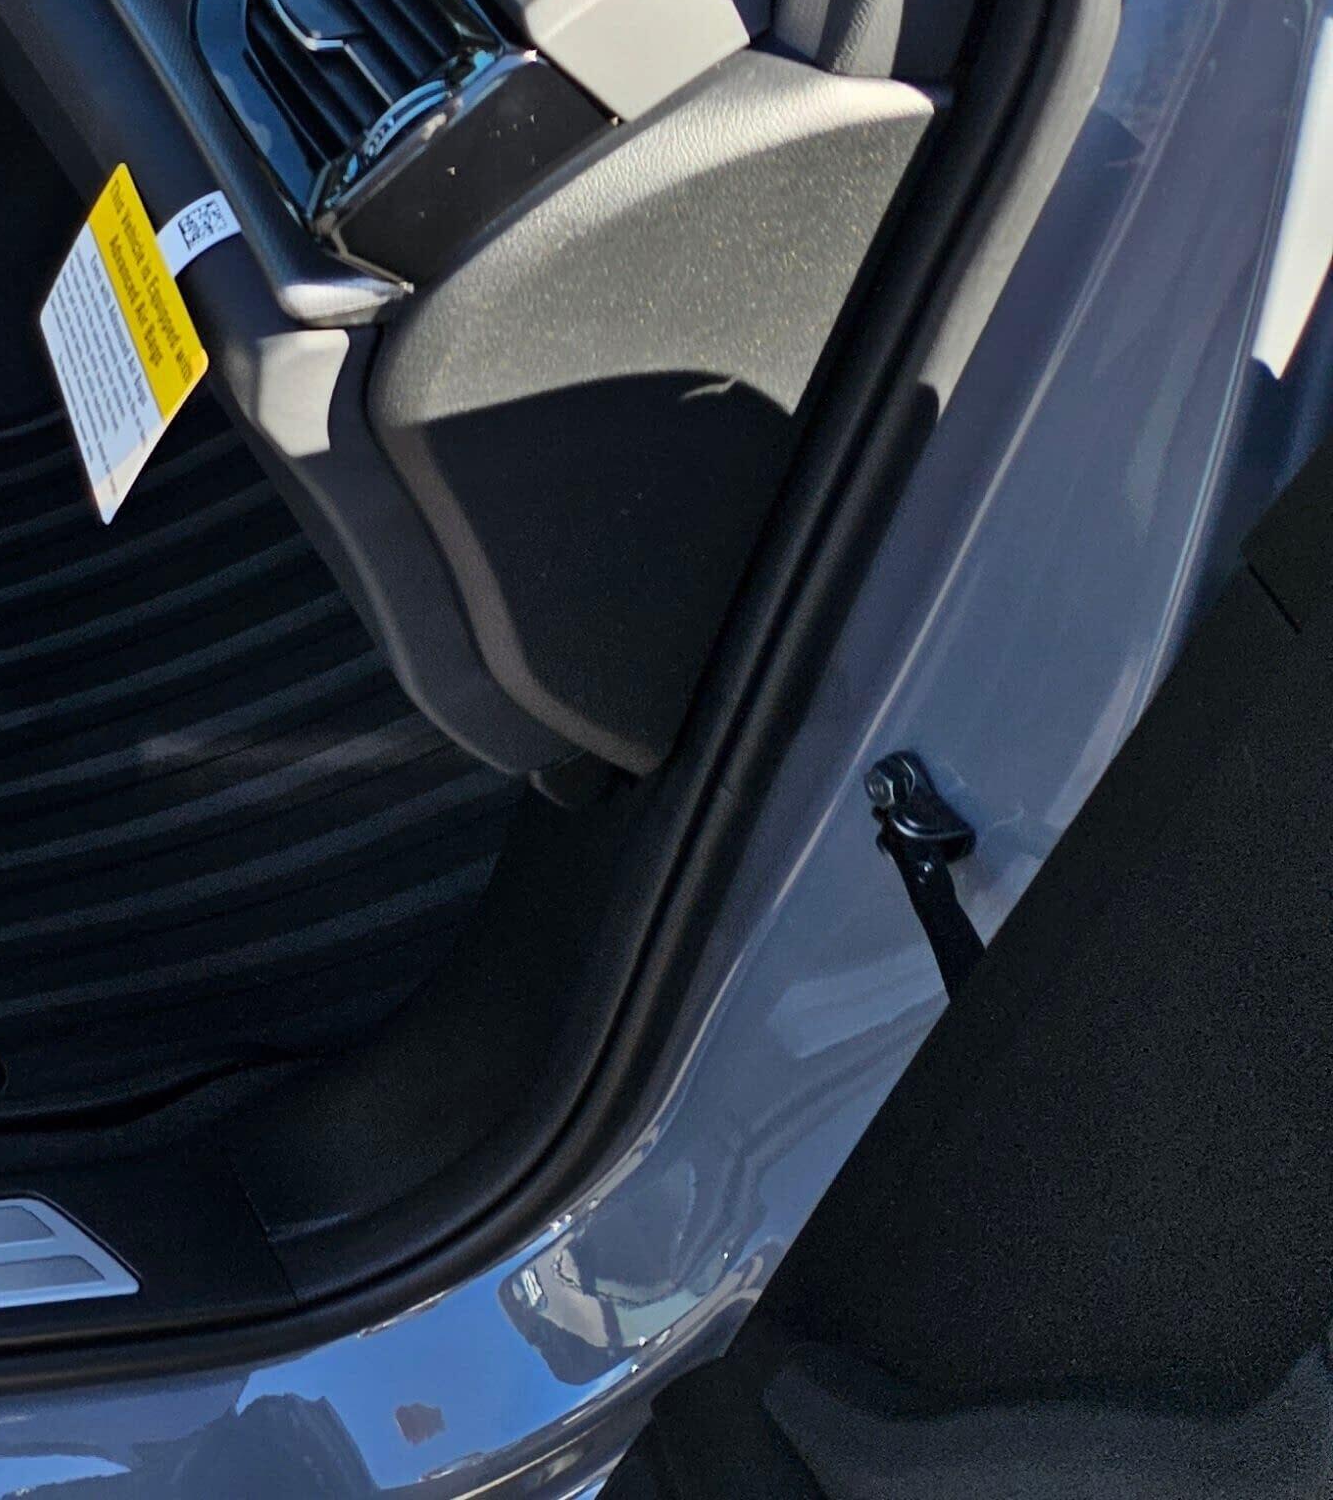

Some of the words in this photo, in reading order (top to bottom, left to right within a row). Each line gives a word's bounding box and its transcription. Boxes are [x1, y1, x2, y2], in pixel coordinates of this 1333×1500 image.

[107, 228, 141, 308] Advanced
[119, 205, 147, 269] Vehicle
[145, 271, 181, 354] Equipped
[133, 296, 150, 331] Air
[140, 320, 165, 374] Bags
